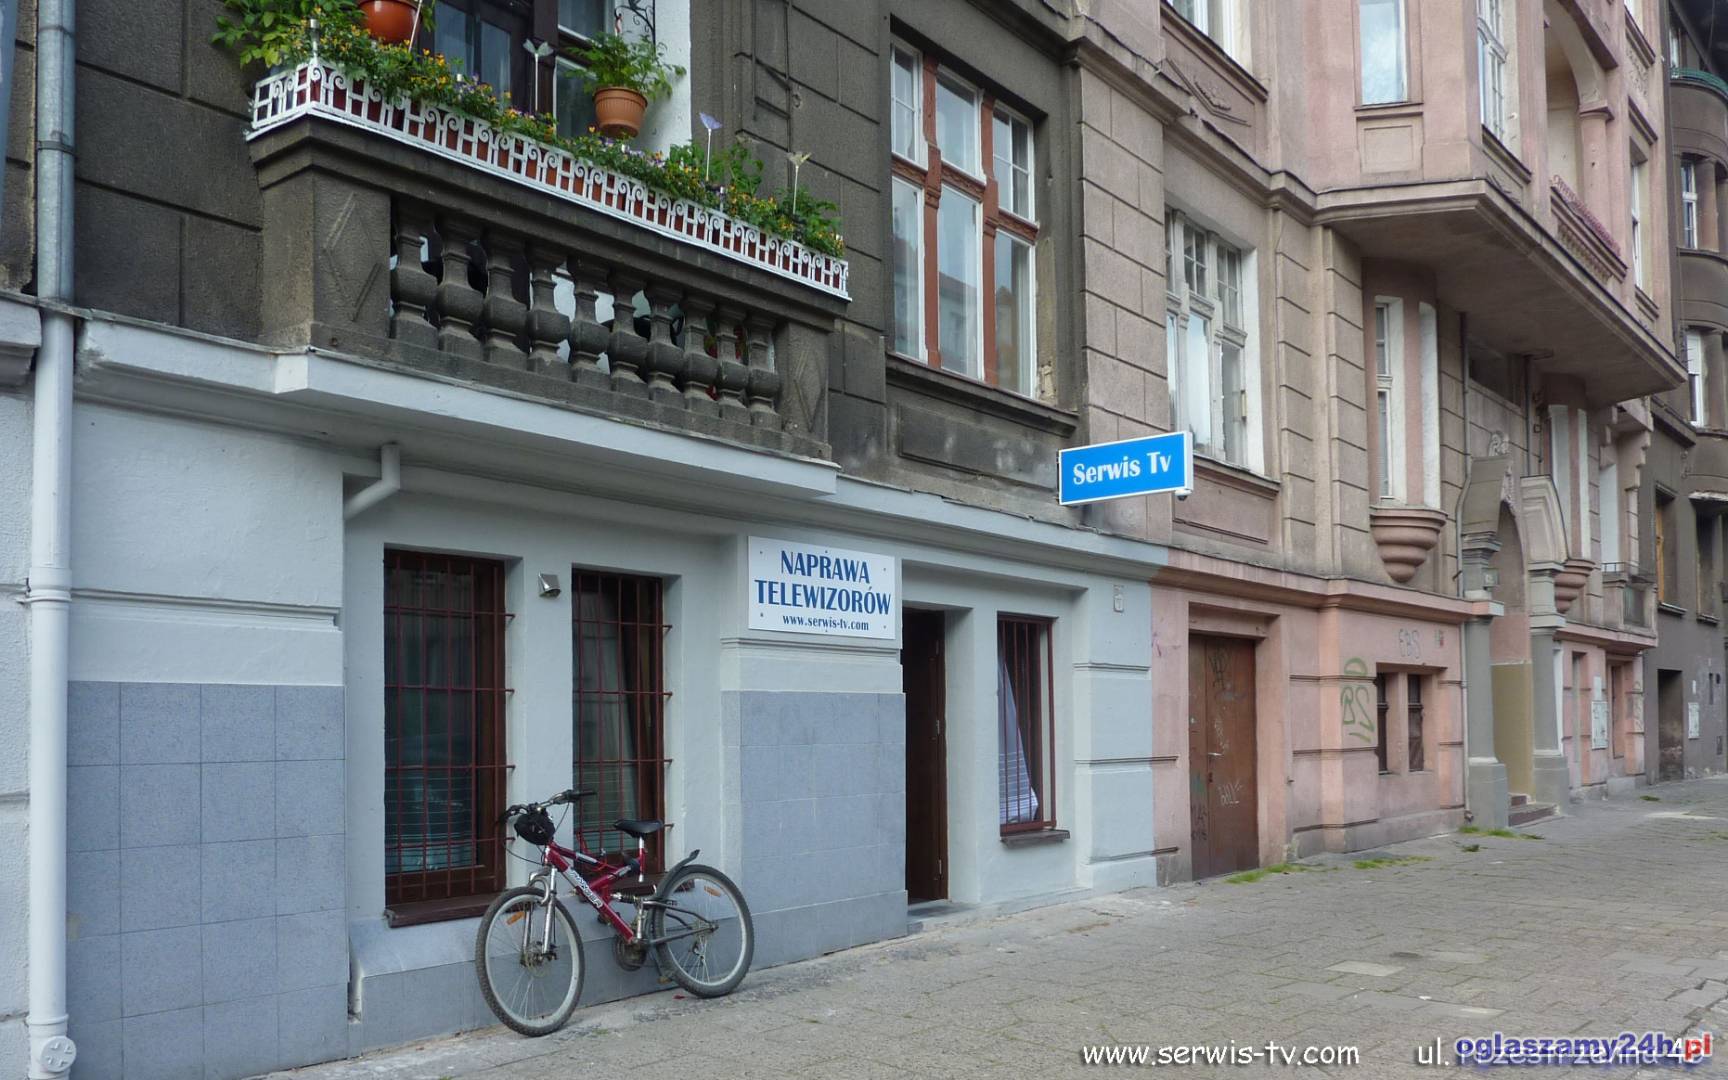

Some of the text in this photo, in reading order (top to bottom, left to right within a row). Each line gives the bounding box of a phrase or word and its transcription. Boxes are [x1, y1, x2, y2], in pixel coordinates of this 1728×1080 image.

[1073, 451, 1172, 485] Serwis Tv
[781, 550, 870, 584] NAPRAWA
[754, 579, 891, 615] TELEWIZORÓW
[783, 615, 869, 631] www.serwis-tv.com
